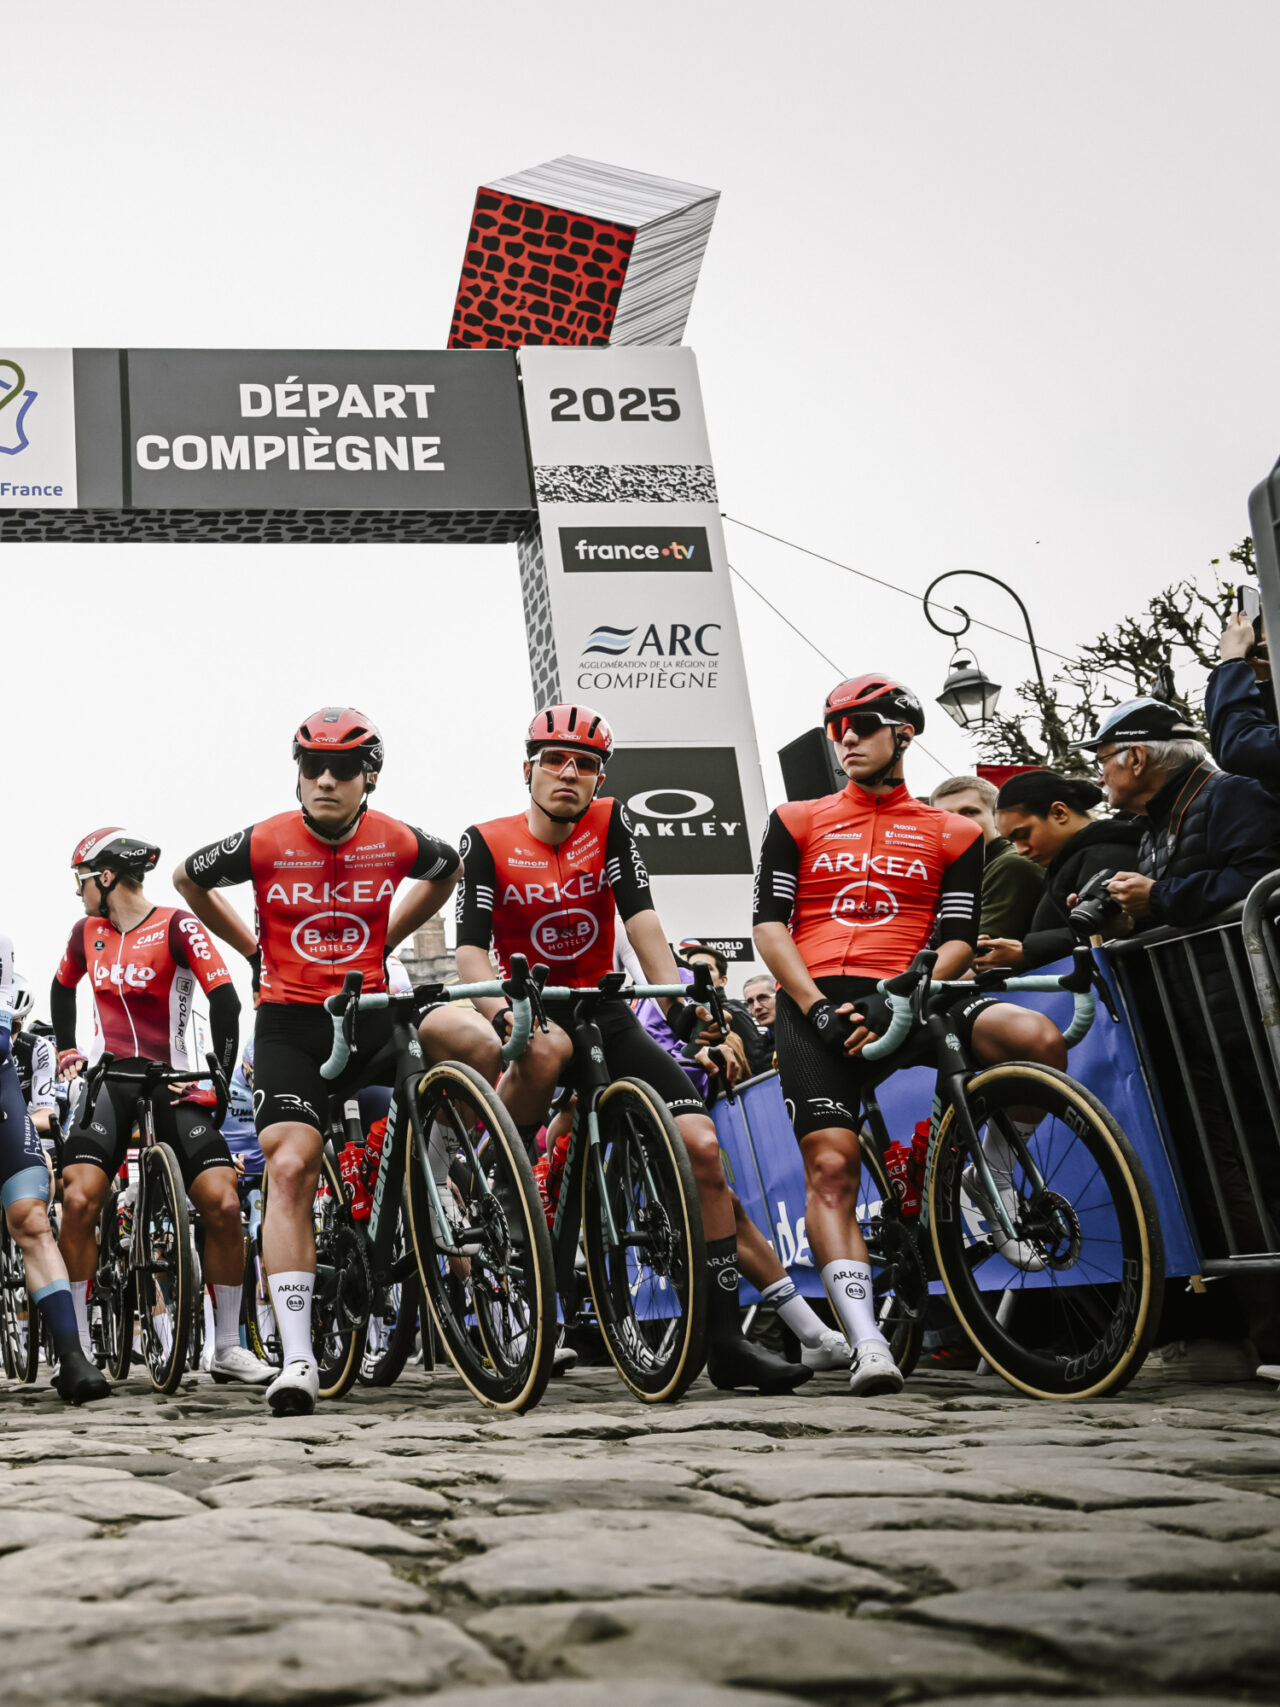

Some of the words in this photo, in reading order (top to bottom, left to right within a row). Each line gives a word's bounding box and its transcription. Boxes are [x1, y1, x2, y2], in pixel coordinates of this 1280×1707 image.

[239, 376, 435, 418] DÉPART
[549, 387, 681, 422] 2025
[136, 428, 445, 471] COMPIÈGNE
[637, 623, 722, 656] ARC
[578, 660, 647, 669] AGGLOMÉRATION
[676, 659, 705, 668] RÉGION
[708, 660, 718, 668] DE
[577, 668, 718, 690] COMPIÈGNE
[633, 822, 737, 837] AKLEY
[193, 845, 220, 875] ARKEA
[357, 852, 396, 860] LEGENDRE
[508, 857, 549, 867] Bianchi
[629, 838, 649, 889] ARKEA
[811, 852, 928, 880] ARKEA
[266, 878, 395, 905] ARKEA
[503, 868, 611, 905] ARKEA
[137, 929, 166, 945] CAPS
[310, 944, 353, 953] HOTELS
[707, 941, 743, 950] WORLD
[178, 995, 187, 1037] SOLAR
[222, 1037, 234, 1067] vermarc
[368, 1097, 398, 1242] Bianchi
[833, 1271, 870, 1283] ARKEA
